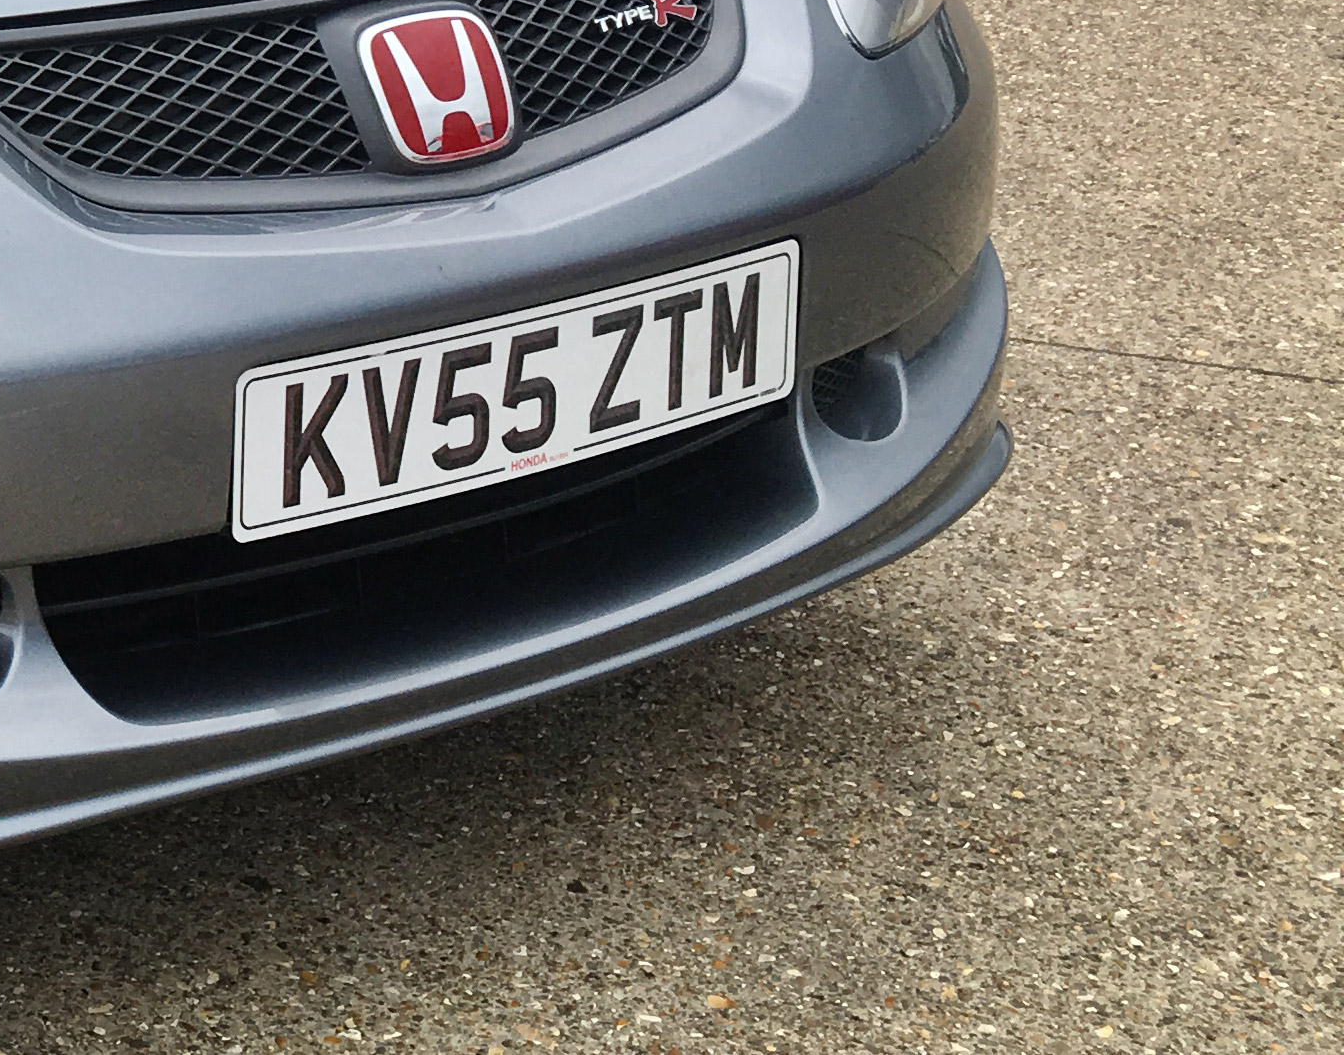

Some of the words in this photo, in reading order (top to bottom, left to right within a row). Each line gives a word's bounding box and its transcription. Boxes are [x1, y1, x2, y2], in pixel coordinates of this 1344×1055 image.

[594, 5, 654, 33] TYPE
[281, 326, 560, 509] KV55
[589, 272, 761, 434] ZTM
[511, 453, 548, 472] HONDA
